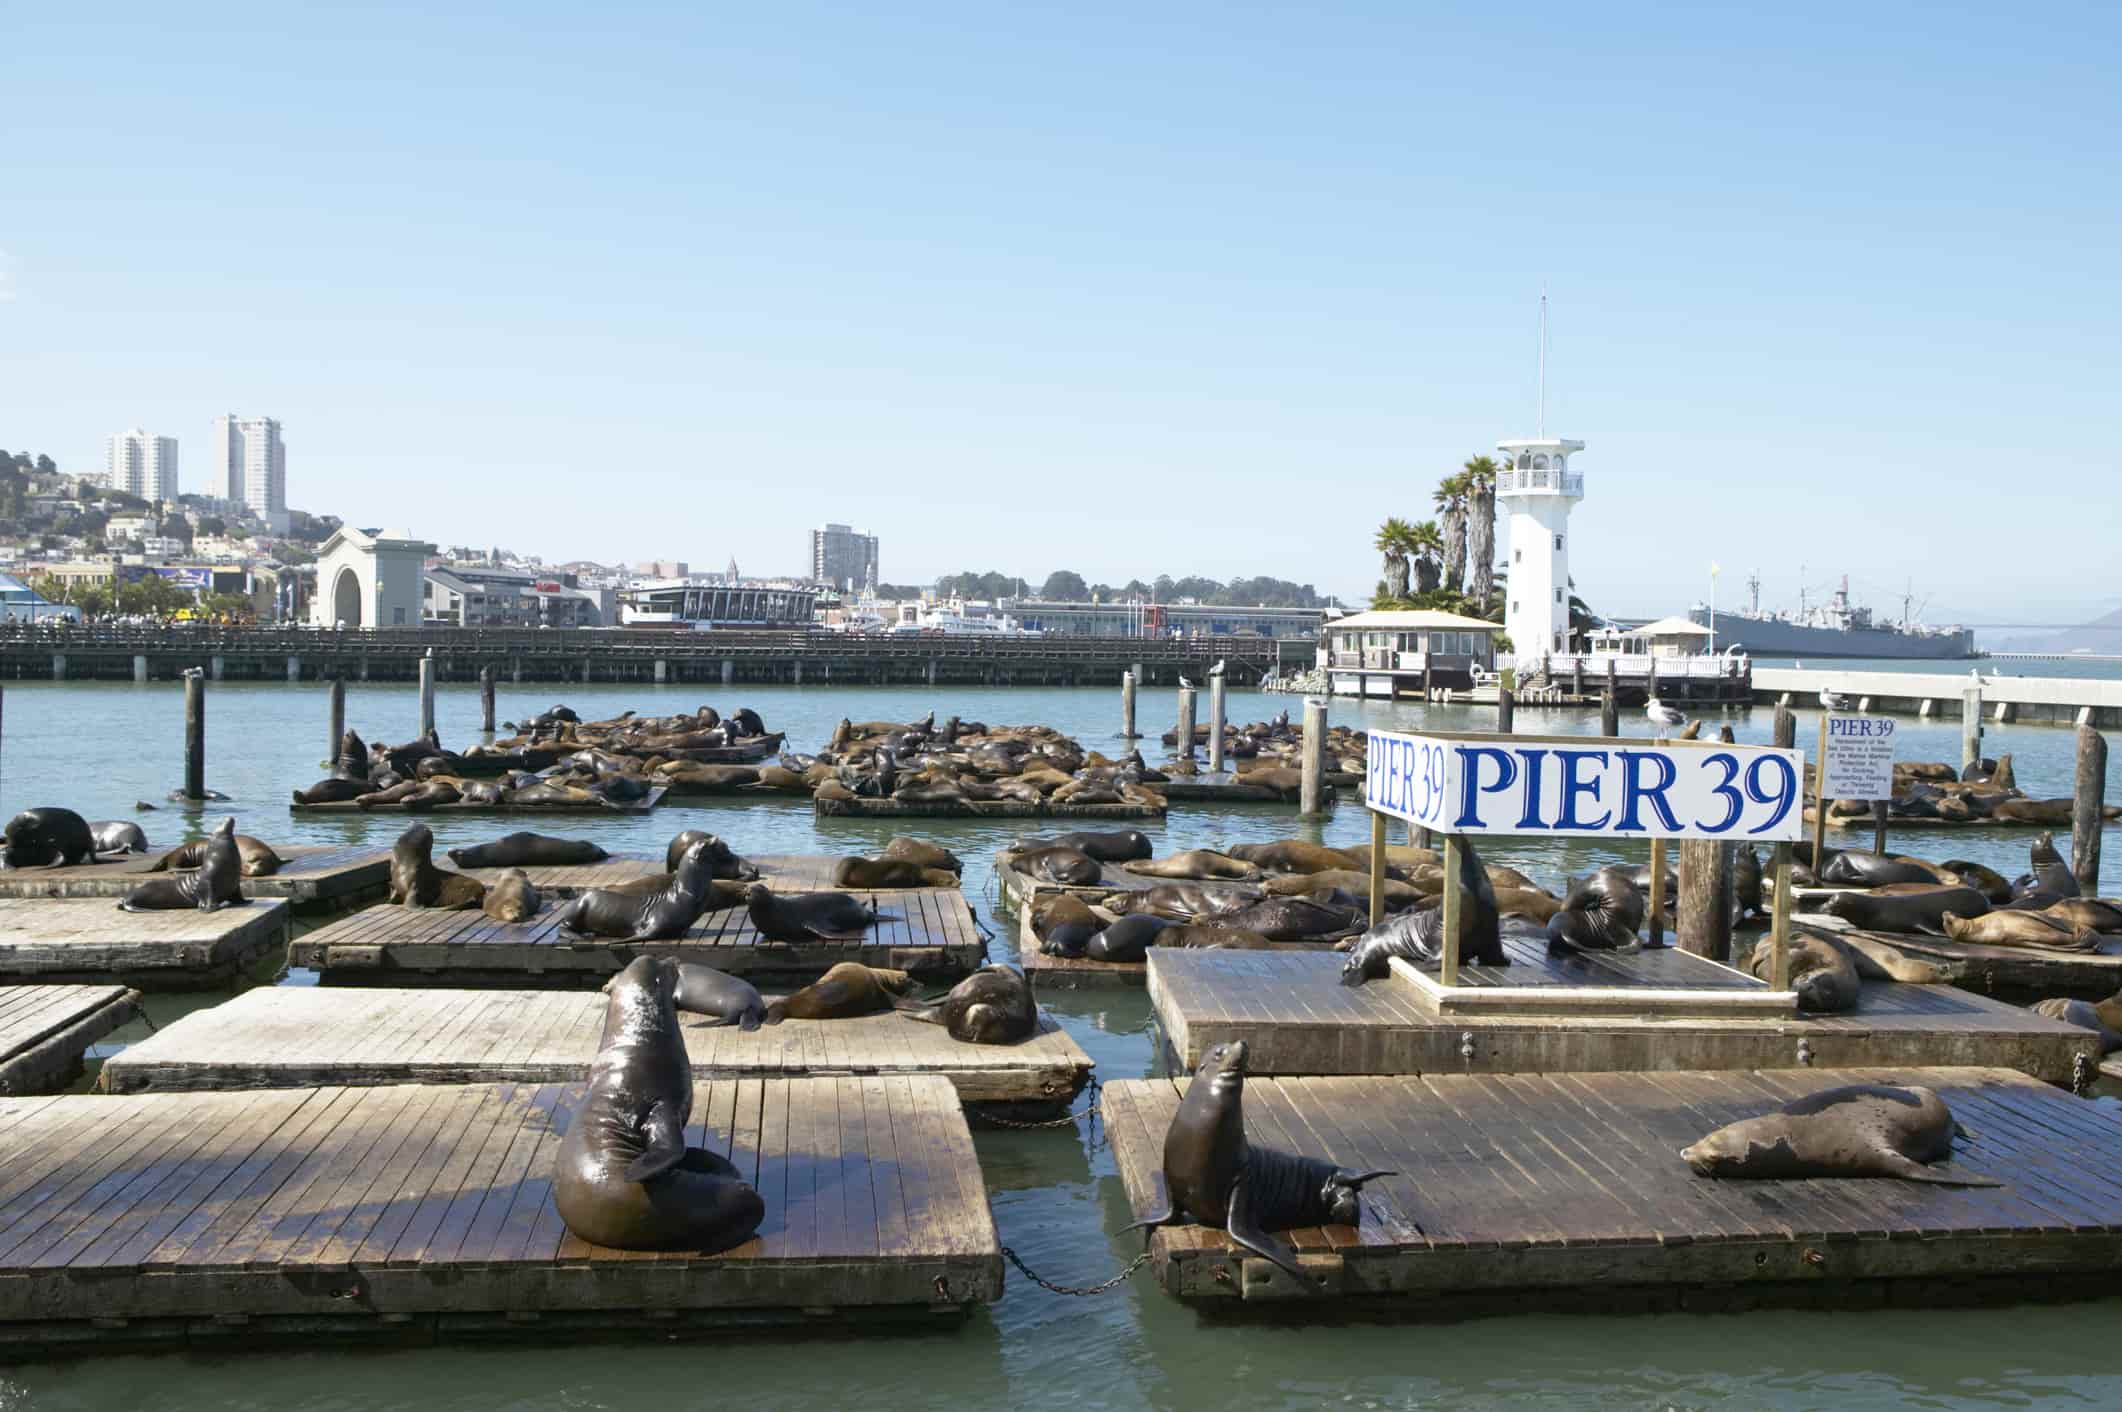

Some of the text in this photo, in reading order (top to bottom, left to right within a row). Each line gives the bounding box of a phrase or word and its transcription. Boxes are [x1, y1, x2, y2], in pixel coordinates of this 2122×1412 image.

[1829, 719, 1894, 736] PIER 39
[1368, 735, 1444, 822] PIER 39
[1453, 747, 1797, 834] PIER 39
